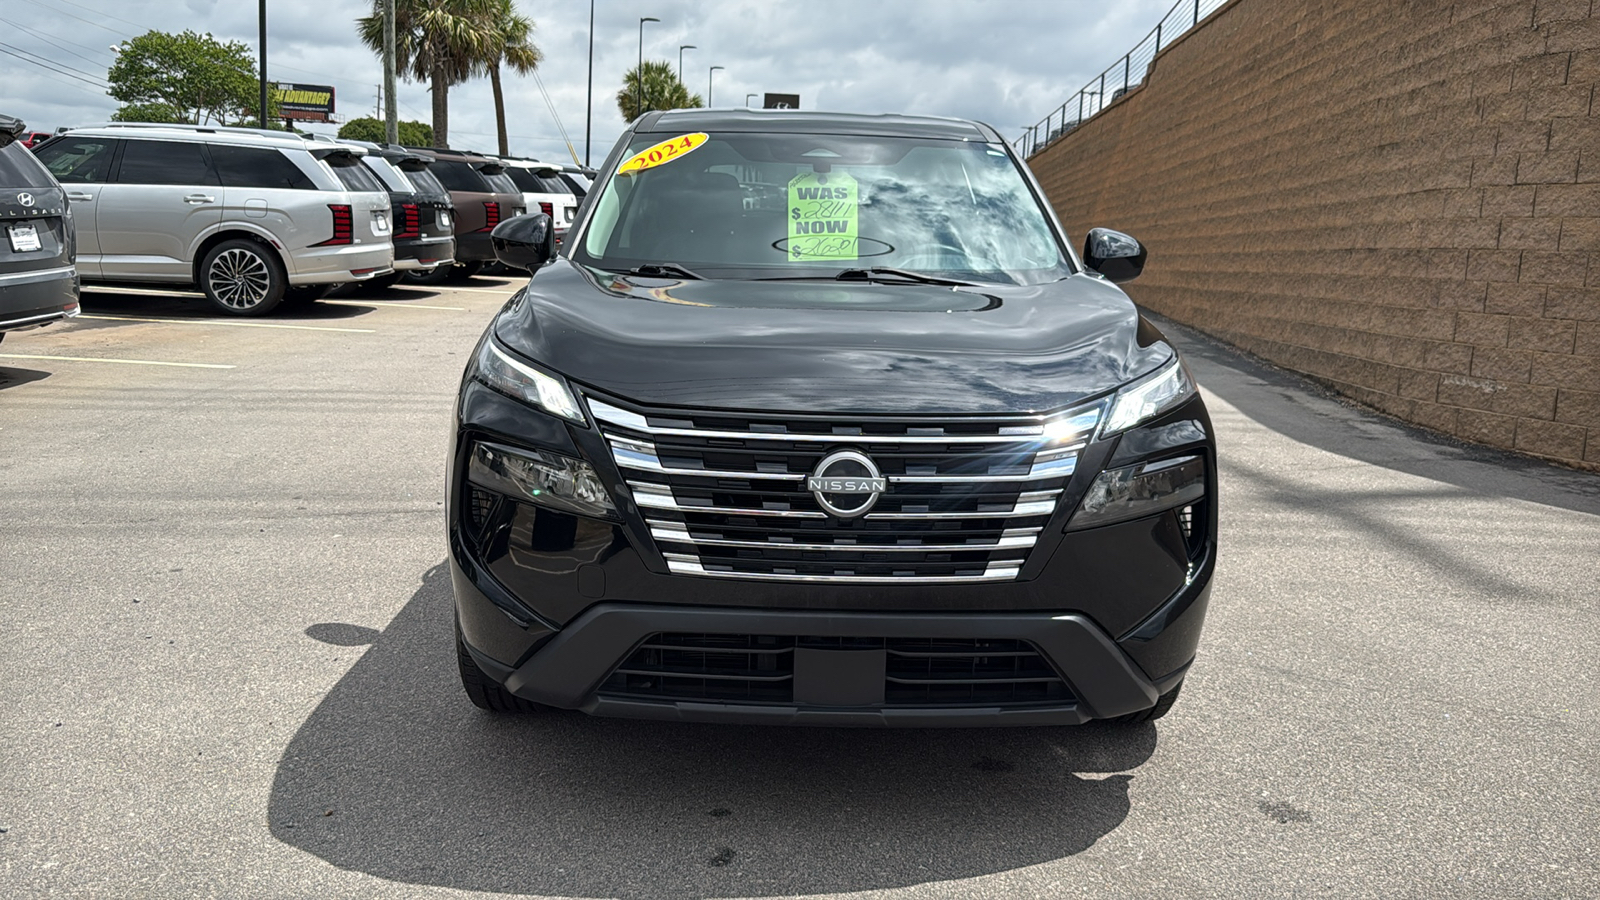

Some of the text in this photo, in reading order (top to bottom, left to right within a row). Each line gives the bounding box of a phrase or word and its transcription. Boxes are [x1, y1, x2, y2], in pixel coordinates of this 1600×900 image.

[284, 90, 330, 105] ADVANTAGE?
[634, 136, 693, 168] 2024
[797, 187, 848, 200] WAS
[0, 208, 62, 216] LISADE
[796, 220, 848, 234] NOW
[809, 479, 884, 491] NISSAN
